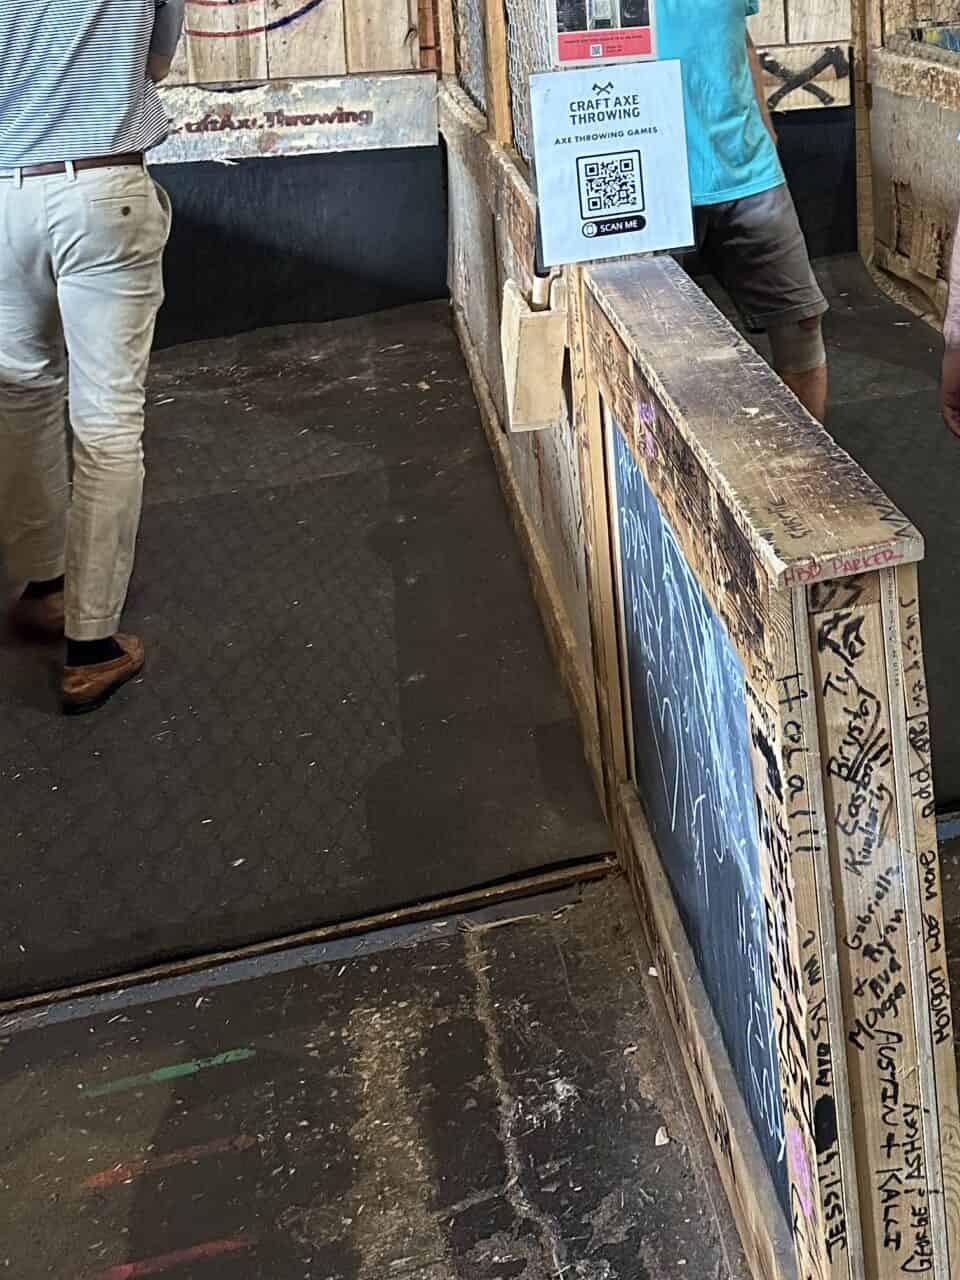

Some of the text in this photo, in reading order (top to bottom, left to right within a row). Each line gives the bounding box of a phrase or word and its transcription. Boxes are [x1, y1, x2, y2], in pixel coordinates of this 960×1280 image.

[569, 94, 640, 113] CRAFT AXE
[569, 106, 641, 126] THROWING
[554, 125, 658, 146] AXE THROWING GAMES
[599, 219, 638, 233] SCAN ME
